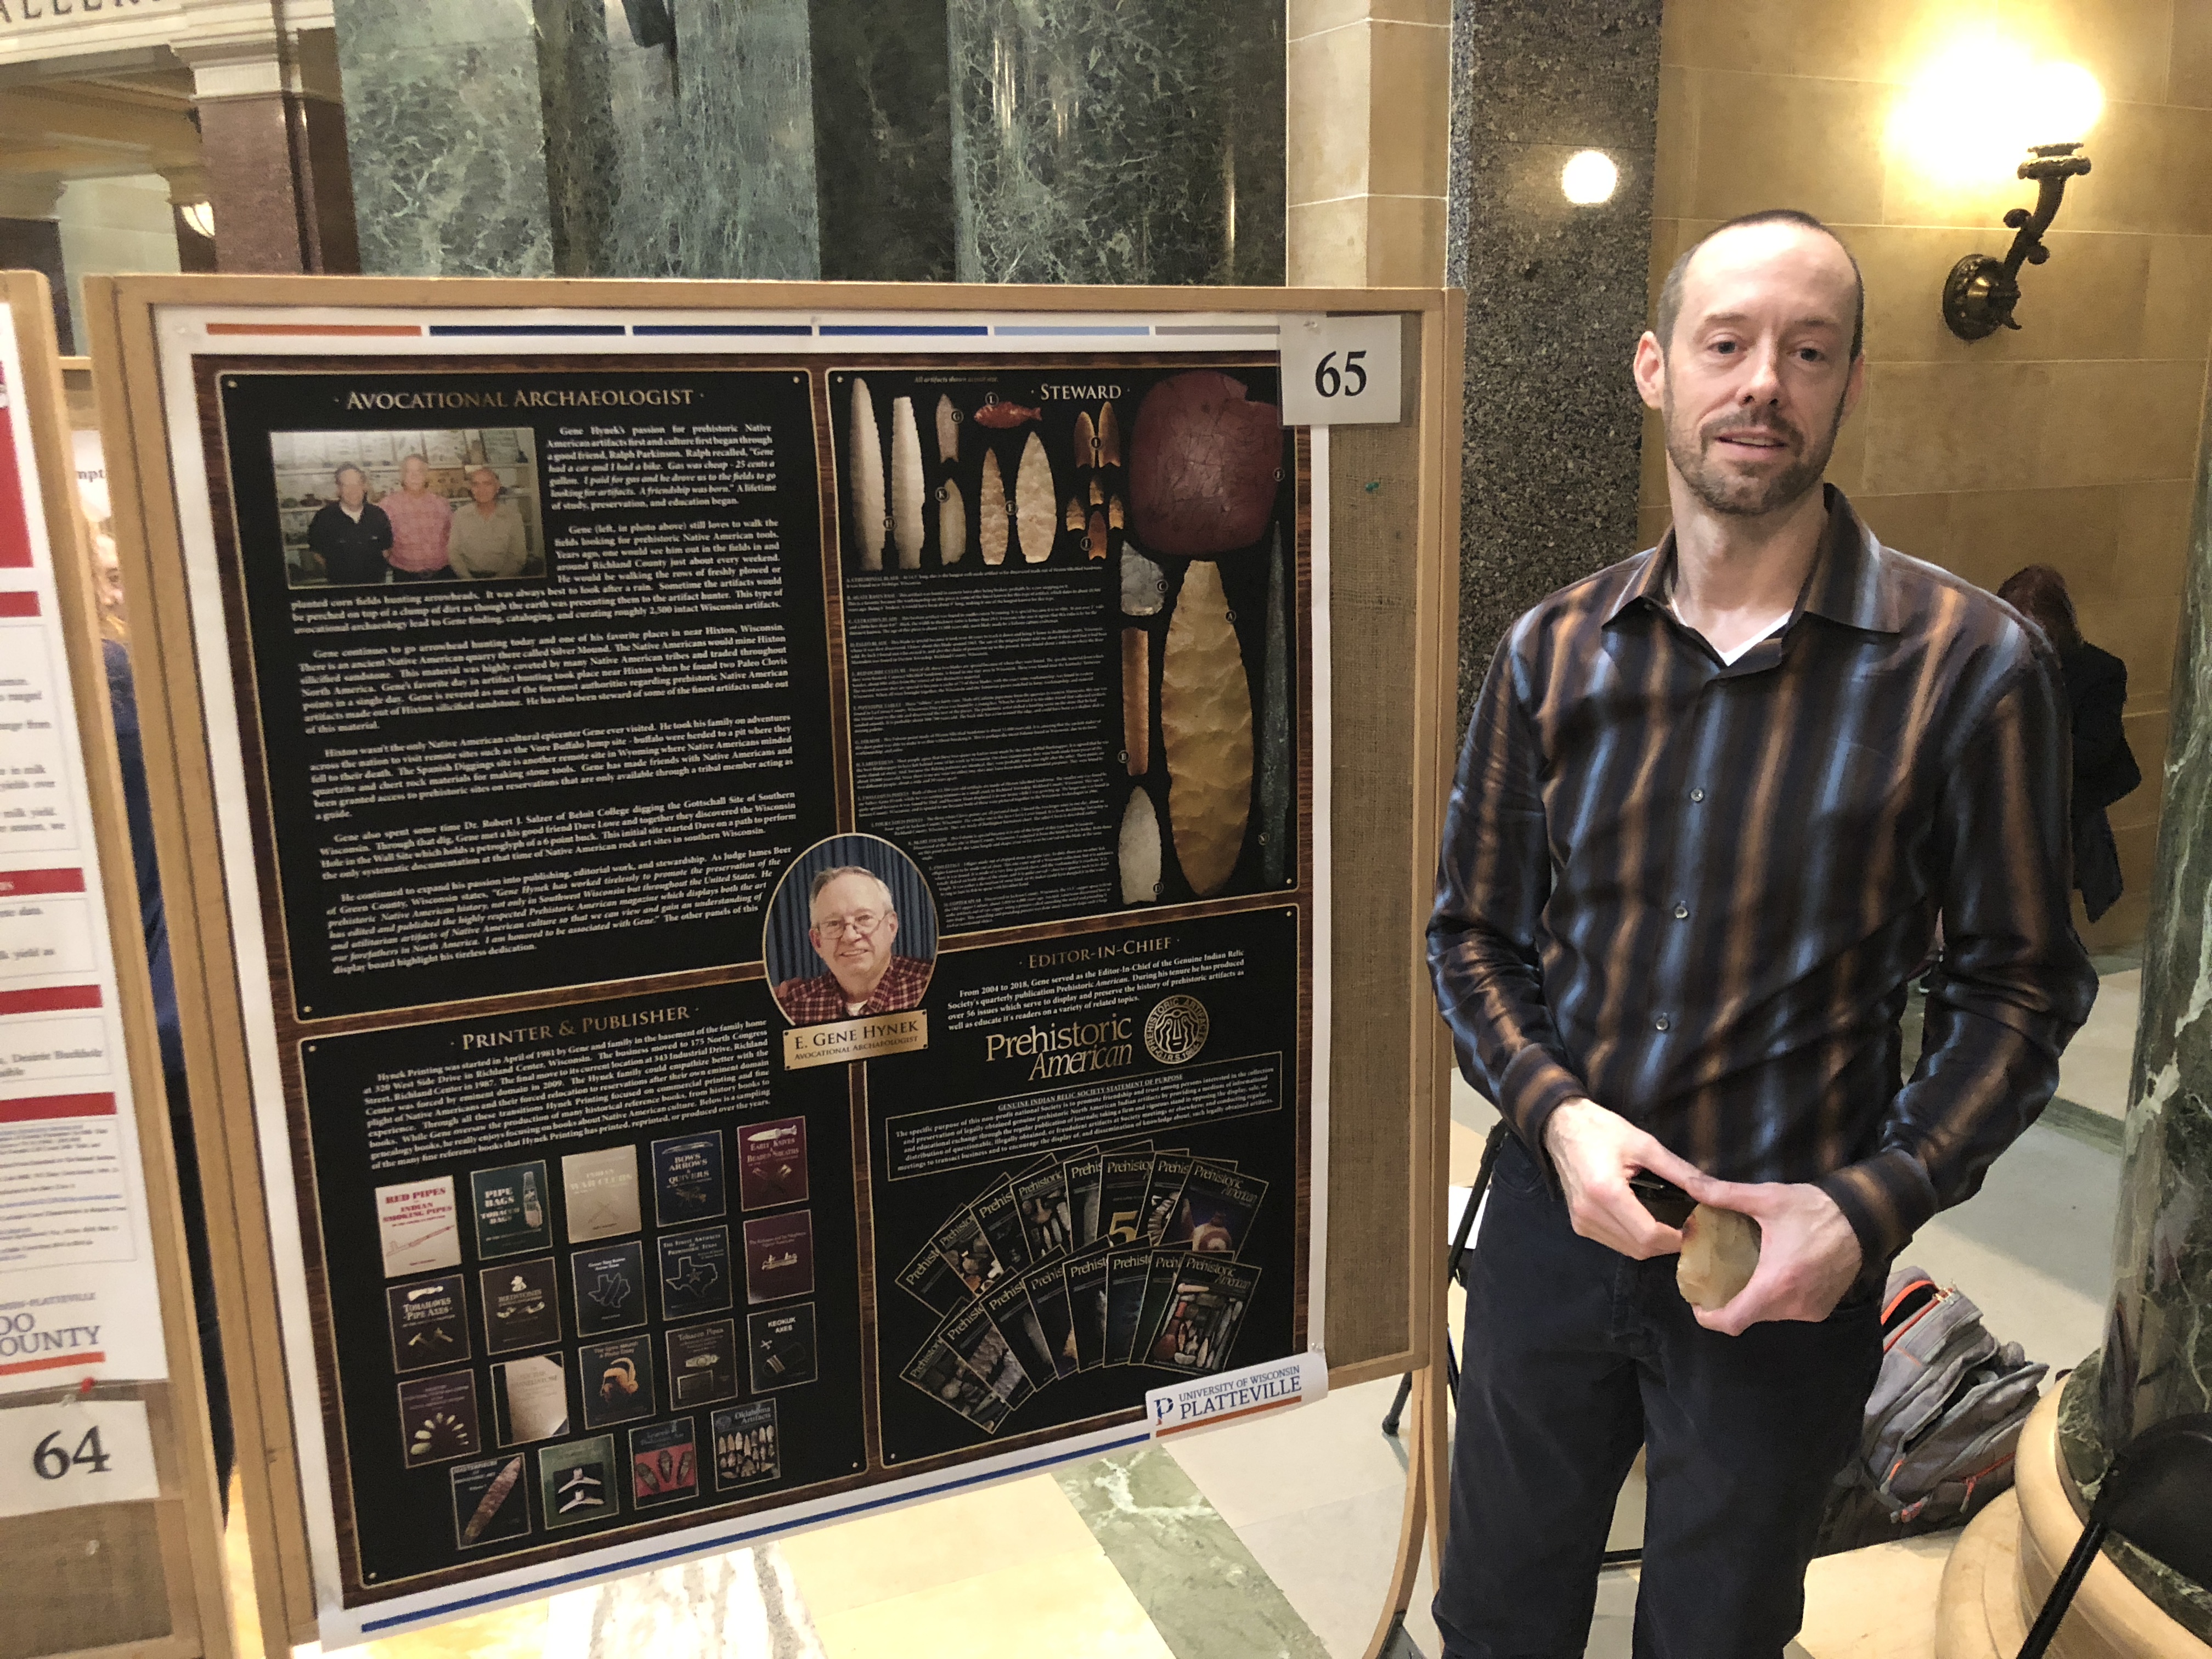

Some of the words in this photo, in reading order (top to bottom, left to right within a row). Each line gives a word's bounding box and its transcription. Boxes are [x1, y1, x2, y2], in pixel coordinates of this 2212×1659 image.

[1315, 350, 1367, 397] 65
[347, 391, 508, 410] AVOCATIONAL
[514, 388, 695, 408] ARCHAEOLOGIST
[1040, 383, 1121, 400] STEWARD
[1029, 937, 1172, 969] EDITOR-IN-CHIEF
[947, 998, 979, 1010] Society's
[980, 994, 1013, 1007] quarterly
[1014, 989, 1055, 1001] publication
[1056, 981, 1094, 993] Prehistoric
[1132, 973, 1158, 981] During
[1212, 958, 1244, 971] produced
[959, 990, 980, 998] From
[981, 985, 999, 994] 2004
[1051, 973, 1074, 983] served
[1098, 962, 1151, 977] Editor-In-Chief
[1173, 956, 1203, 965] Genuine
[1204, 952, 1226, 961] Indian
[1000, 1002, 1022, 1012] which
[1052, 995, 1077, 1004] display
[1079, 991, 1092, 1000] and
[1094, 988, 1123, 999] preserve
[1137, 979, 1161, 990] history
[1171, 975, 1207, 987] prehistoric
[1208, 971, 1236, 980] artifacts
[462, 1025, 553, 1050] PRINTER
[558, 1019, 577, 1036] &
[582, 1007, 691, 1032] PUBLISHER
[948, 1022, 963, 1030] well
[974, 1017, 1002, 1027] educate
[1015, 1011, 1042, 1020] readers
[1093, 997, 1116, 1007] related
[1147, 998, 1179, 1052] PREHISTORIC
[1183, 999, 1206, 1042] ARTIFACTS
[794, 1047, 850, 1060] AVOCATIONAL
[853, 1036, 918, 1052] ARCHAEOLOGIST
[795, 1036, 808, 1049] E.
[813, 1029, 857, 1046] GENE
[864, 1020, 919, 1040] HYNEK
[985, 1013, 1133, 1062] Prehistoric
[1028, 1043, 1133, 1081] American
[998, 1100, 1030, 1111] GENUINE
[1030, 1096, 1056, 1106] INDIAN
[1056, 1092, 1076, 1102] RELIC
[1076, 1087, 1105, 1098] SOCIETY
[1106, 1080, 1143, 1093] STATEMENT
[1154, 1074, 1183, 1084] PURPOSE
[668, 1158, 708, 1172] ARROWS
[674, 1153, 701, 1164] BOWS
[1019, 1170, 1063, 1197] Prehistoric
[1194, 1166, 1244, 1189] Prehistoric
[386, 1193, 410, 1204] RED
[413, 1187, 446, 1199] PIPES
[485, 1187, 513, 1199] PIPE
[1186, 1257, 1235, 1277] Prehistoric
[403, 1297, 452, 1313] TOMAHAWKS
[775, 1324, 793, 1333] AXES
[1179, 1381, 1234, 1402] UNIVERSITY
[1237, 1378, 1248, 1388] OF
[1250, 1365, 1300, 1385] WISCONSIN
[1180, 1375, 1302, 1420] PLATTEVILLE
[735, 1406, 771, 1419] Oklahoma
[33, 1425, 112, 1480] 64
